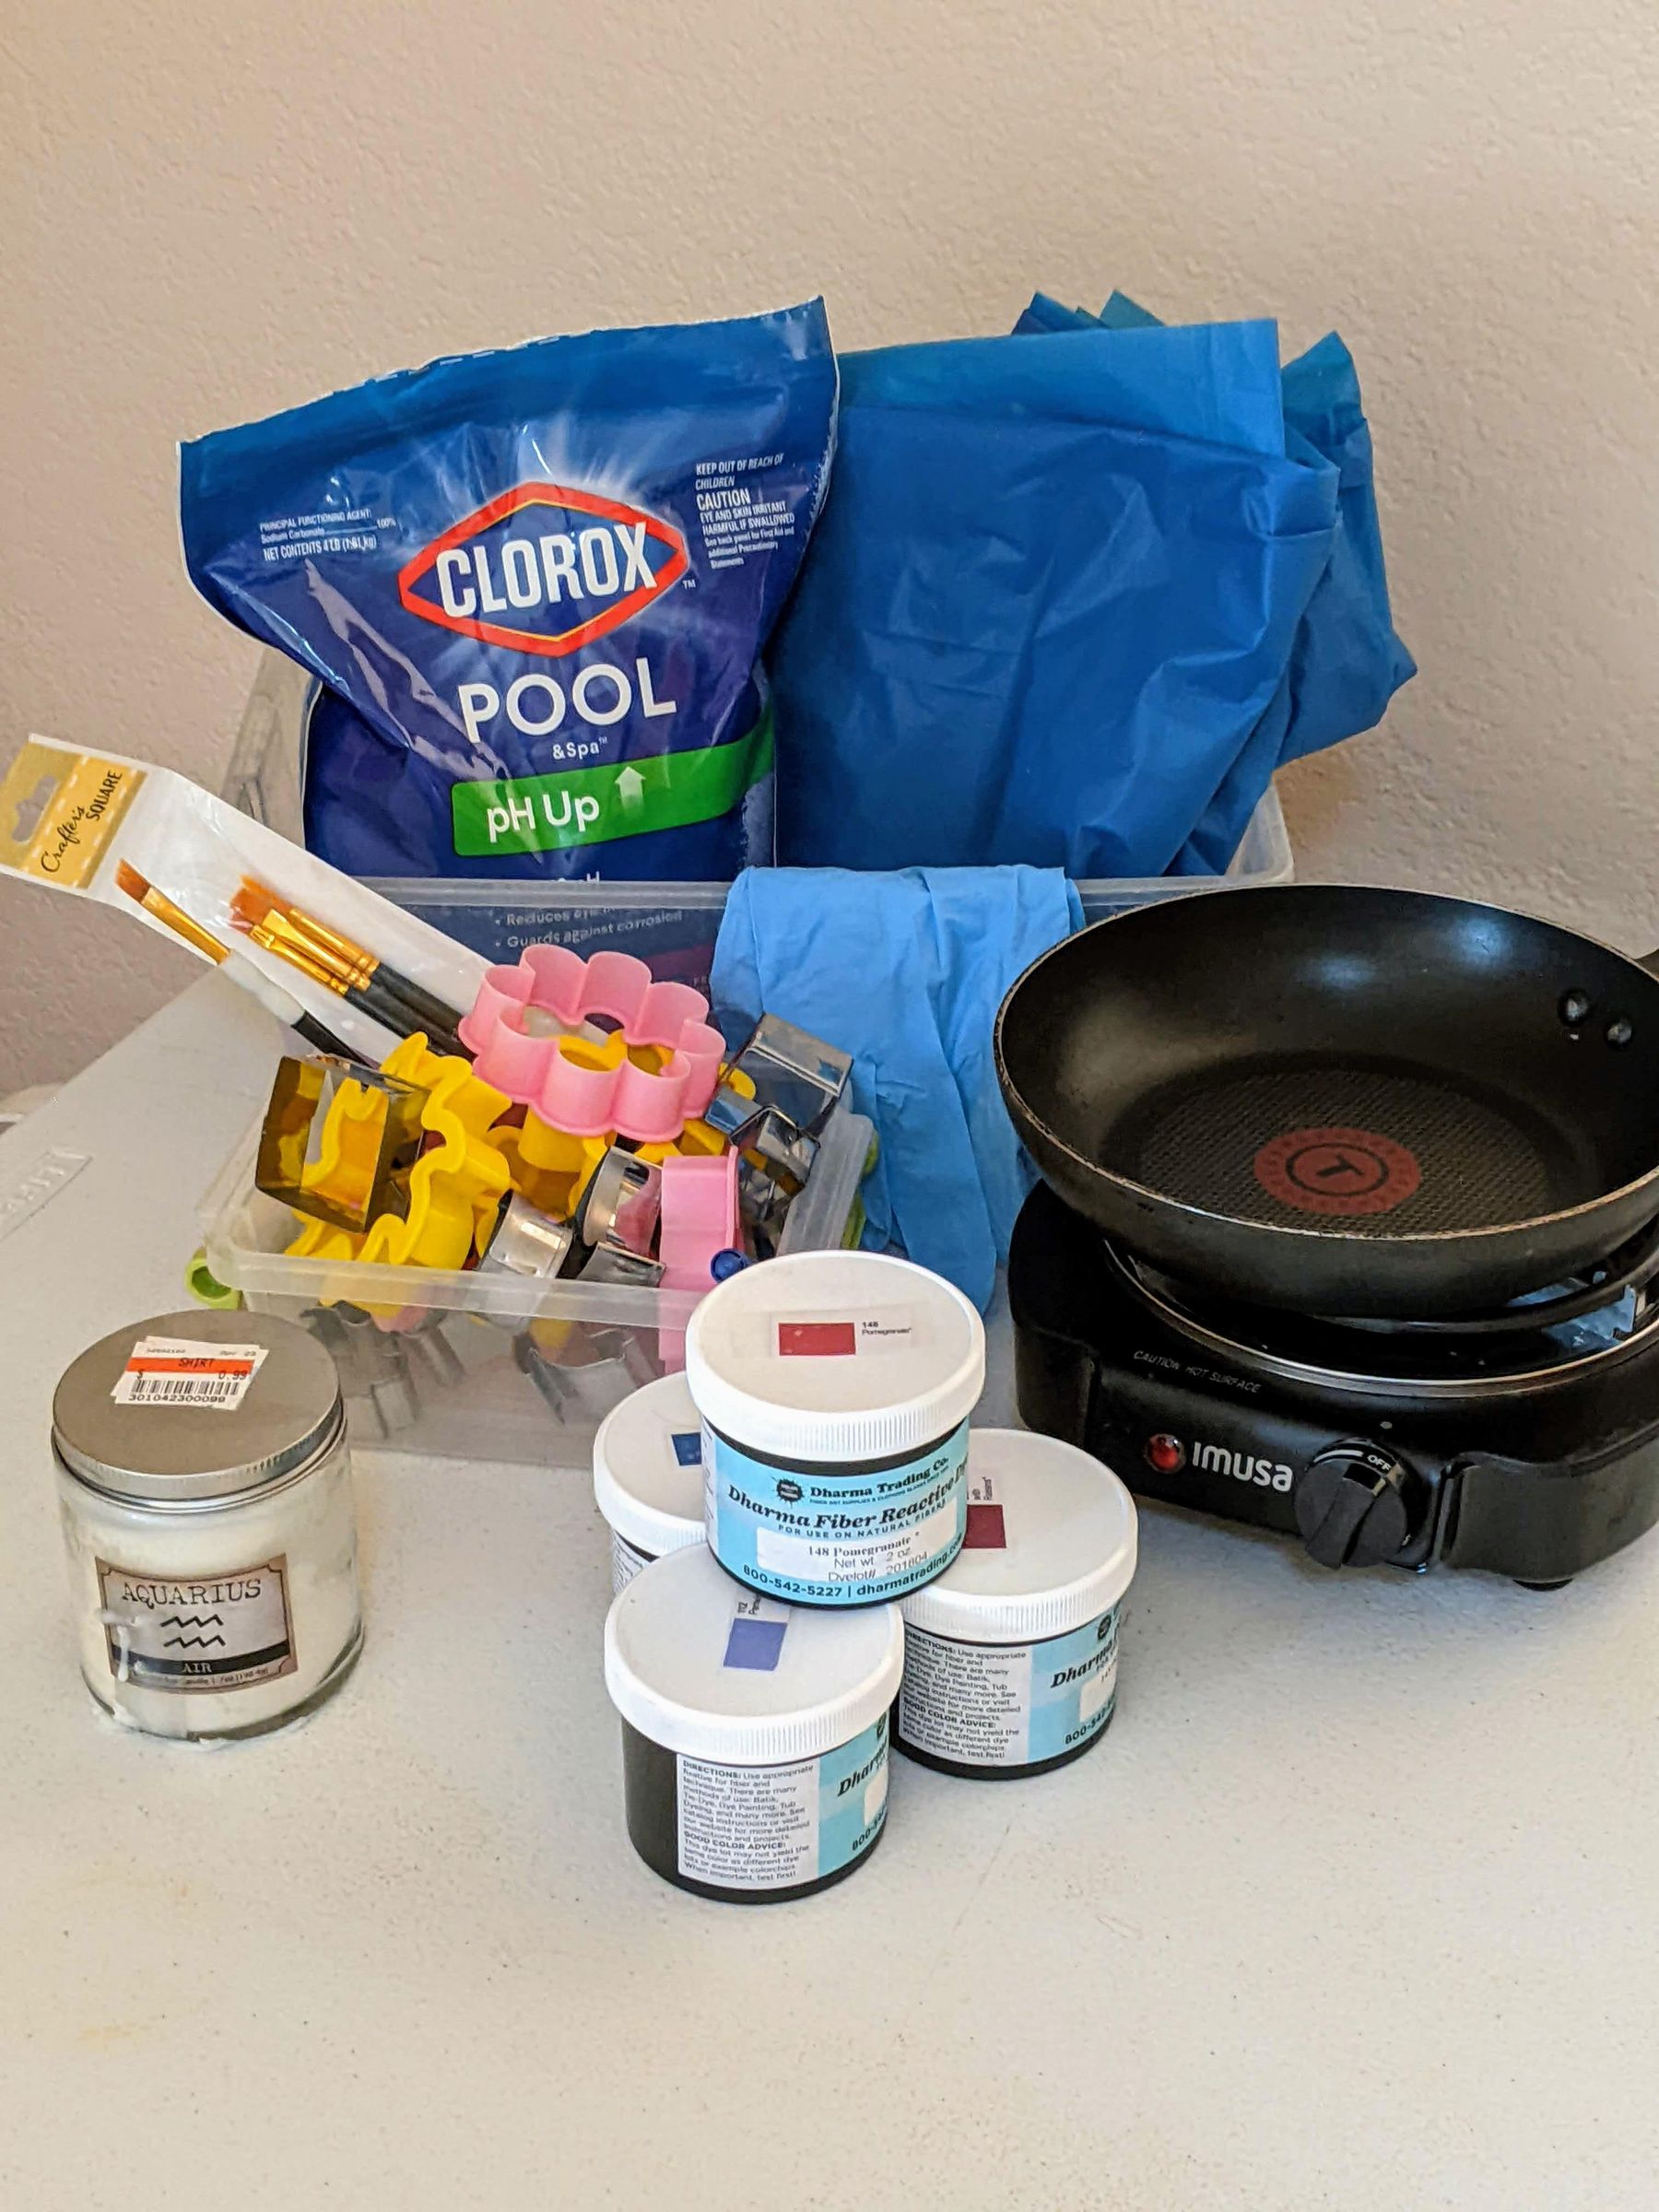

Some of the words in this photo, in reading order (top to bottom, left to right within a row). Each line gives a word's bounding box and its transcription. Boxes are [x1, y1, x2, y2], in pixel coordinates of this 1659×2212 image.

[696, 463, 717, 476] KEEP
[718, 461, 735, 474] OUT
[736, 460, 747, 471] OF
[747, 455, 773, 469] REACH
[773, 453, 784, 465] OF
[695, 476, 735, 490] CHILDREN
[696, 488, 751, 511] CAUTION
[700, 511, 714, 524] EYE
[714, 509, 732, 522] AND
[733, 506, 752, 519] SKIN
[753, 500, 786, 516] IRRITANT
[702, 522, 739, 535] HARMFUL
[739, 519, 747, 531] IF
[747, 512, 795, 529] SWALLOWED
[260, 518, 297, 533] PRINCIPAL
[263, 547, 279, 561] NET
[280, 540, 323, 560] CONTENTS
[436, 522, 657, 618] CLOROX
[458, 657, 677, 743] POOL
[86, 771, 123, 821] SQUARE
[487, 797, 535, 842] pH
[542, 791, 599, 831] Up
[507, 912, 570, 925] Reduces
[507, 932, 560, 947] Guards
[563, 924, 613, 944] against
[218, 1371, 248, 1381] 0.99
[1134, 1350, 1180, 1371] CAUTION
[1185, 1366, 1207, 1378] HOT
[1209, 1371, 1262, 1393] SURFACE
[1368, 1454, 1392, 1470] OFF
[811, 1486, 873, 1498] Dharma
[877, 1466, 931, 1493] Trading
[728, 1485, 810, 1528] Dharma
[813, 1513, 877, 1529] Fiber
[879, 1477, 955, 1525] Reactive
[779, 1524, 802, 1535] FOR
[806, 1530, 830, 1538] USE
[857, 1524, 910, 1538] NATURAL
[808, 1546, 830, 1557] 148
[834, 1559, 855, 1569] Net
[744, 1565, 841, 1598] 800-542-5227
[122, 1579, 262, 1609] AQUARIUS
[182, 1663, 212, 1674] AIR
[838, 1735, 888, 1796] Dhar
